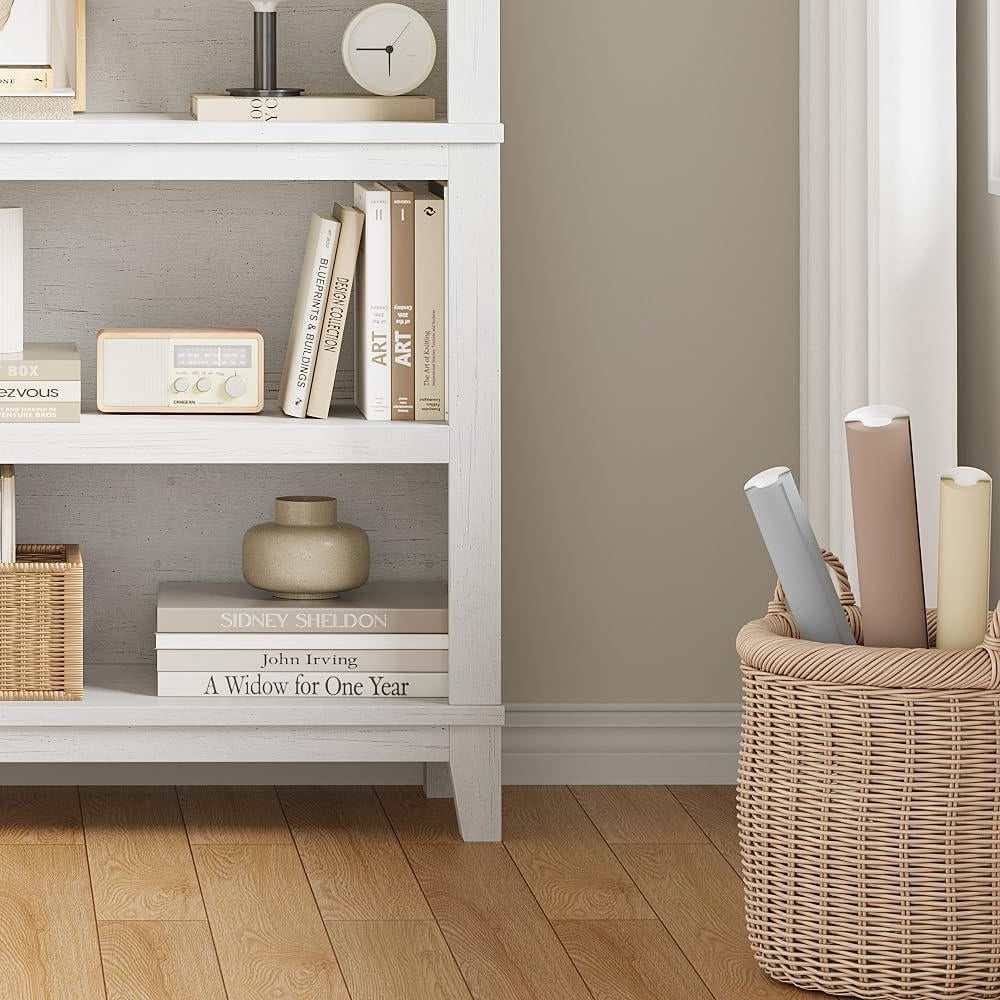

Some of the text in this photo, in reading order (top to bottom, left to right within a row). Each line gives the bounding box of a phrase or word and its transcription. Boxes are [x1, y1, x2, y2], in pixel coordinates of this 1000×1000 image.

[310, 258, 328, 321] BLUEPRINTS
[324, 277, 349, 352] DESIGN COLLECTION
[297, 334, 314, 388] BUILDINGS
[372, 331, 387, 366] ART
[394, 331, 411, 367] ART
[8, 366, 39, 376] BOX
[220, 613, 387, 628] SIDNEY SHELDON
[261, 654, 358, 668] John Irving
[203, 674, 409, 696] A Widow for One Year
